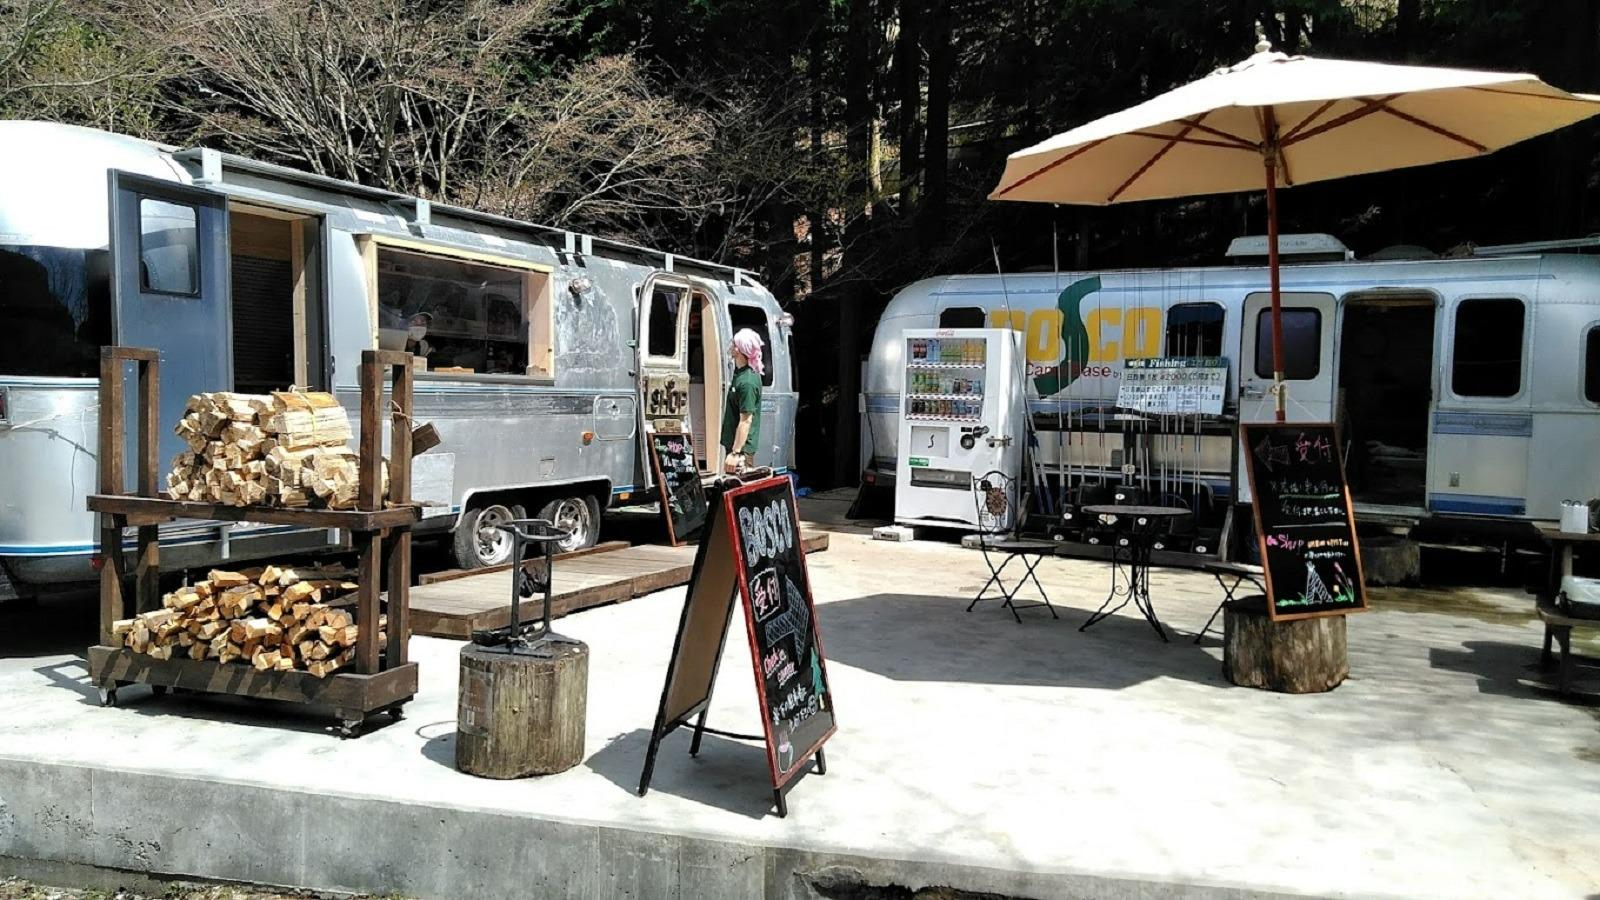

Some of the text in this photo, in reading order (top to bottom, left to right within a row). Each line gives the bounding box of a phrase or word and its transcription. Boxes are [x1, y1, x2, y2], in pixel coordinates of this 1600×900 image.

[1148, 359, 1186, 369] Fishing
[650, 384, 687, 414] SHOP
[1295, 432, 1332, 463] 受付
[739, 498, 793, 567] BOSCO
[753, 574, 780, 616] 受付
